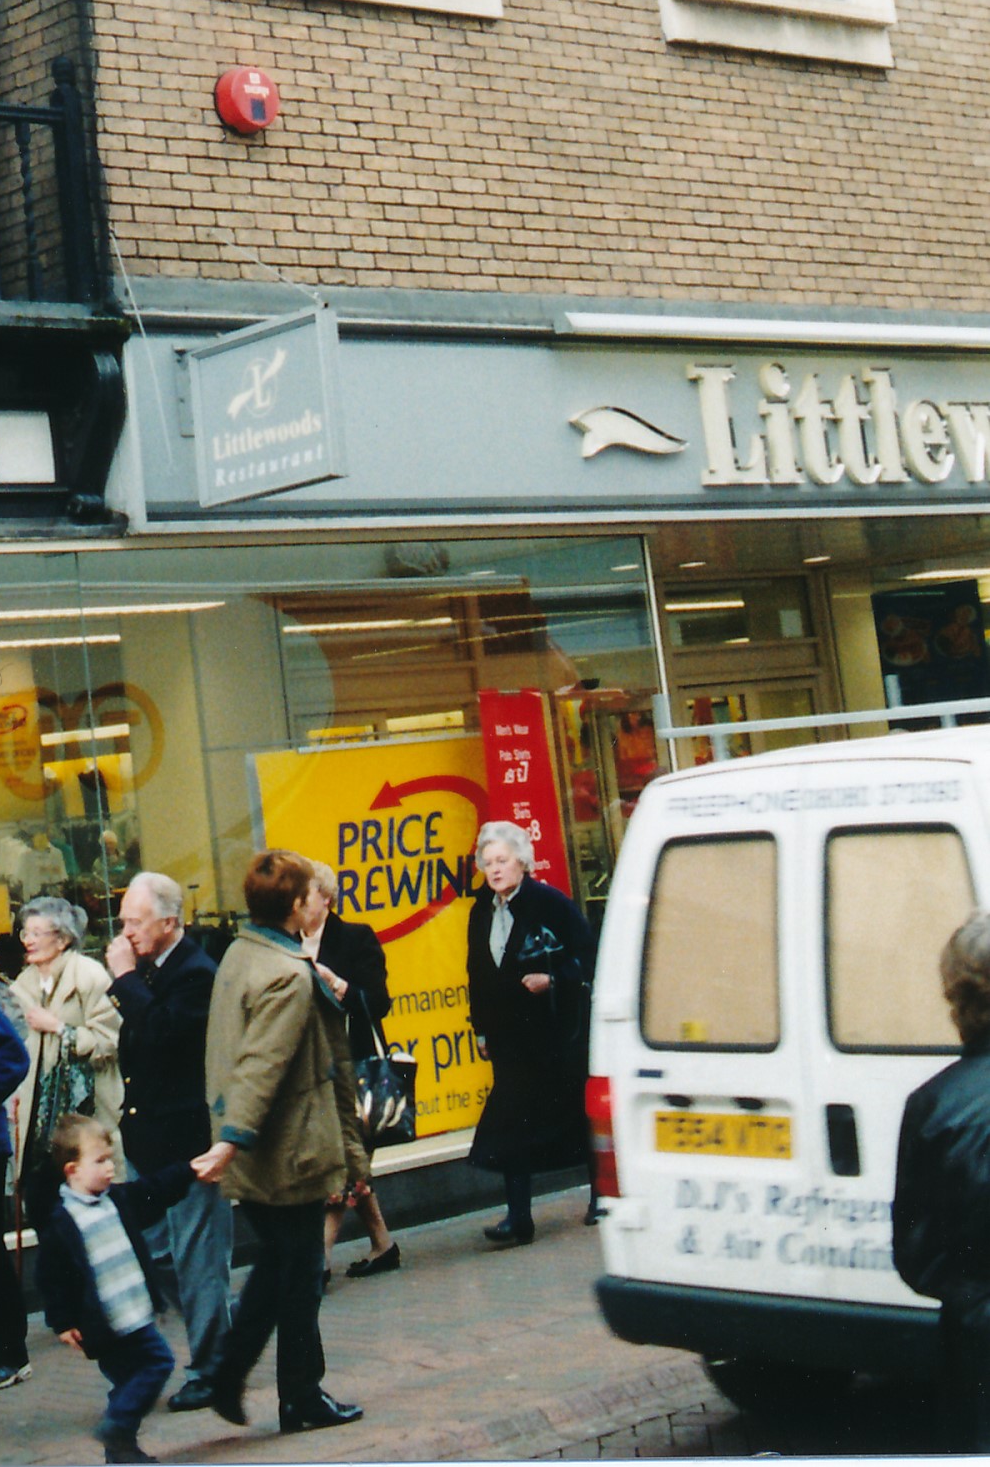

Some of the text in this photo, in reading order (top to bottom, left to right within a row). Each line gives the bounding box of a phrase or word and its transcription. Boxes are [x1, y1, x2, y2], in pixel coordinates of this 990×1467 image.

[213, 410, 322, 461] Littlewoods
[216, 443, 322, 487] Restaurant
[338, 810, 445, 866] PRICE
[389, 984, 470, 1016] rmanen
[447, 1089, 471, 1111] the
